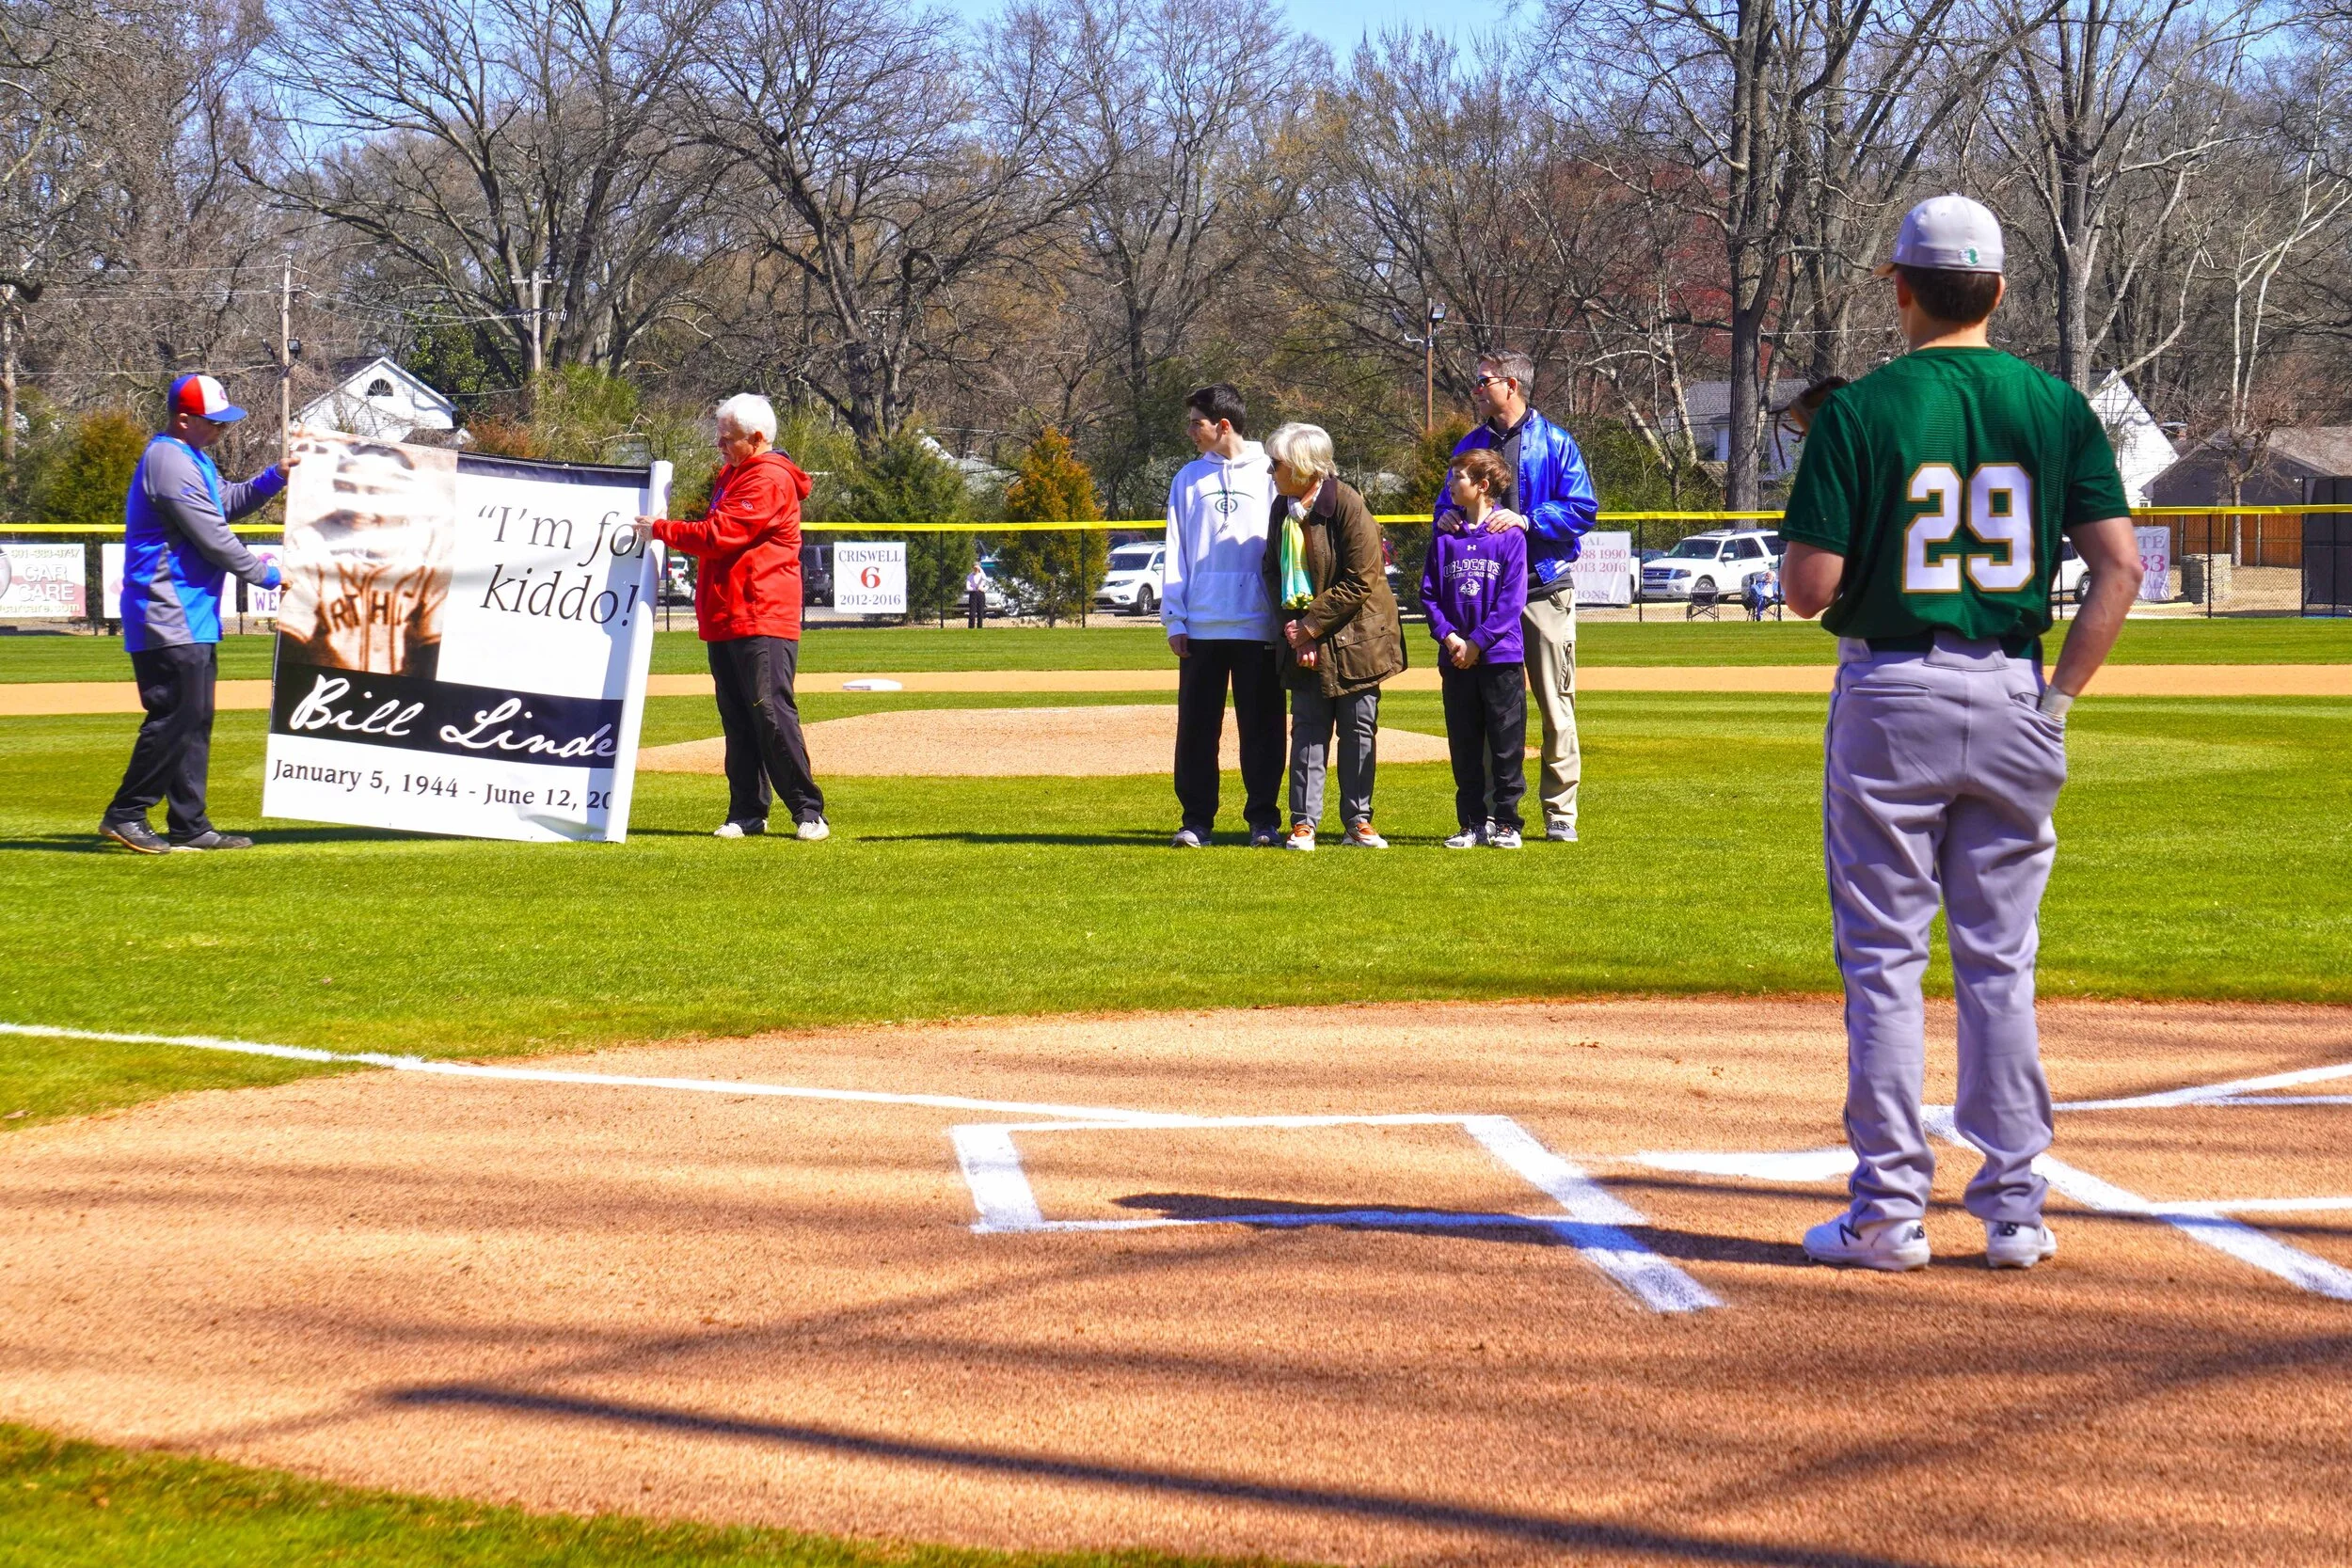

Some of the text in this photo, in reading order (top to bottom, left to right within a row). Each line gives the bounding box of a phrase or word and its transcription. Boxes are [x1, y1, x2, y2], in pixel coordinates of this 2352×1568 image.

[1902, 462, 2035, 593] 29
[838, 550, 901, 562] CRISWELL
[1599, 549, 1626, 560] 1990
[24, 564, 68, 582] CAR
[1571, 562, 1626, 573] 2013 2016
[861, 566, 881, 589] 6
[19, 583, 75, 602] CARE
[255, 592, 281, 610] WE
[480, 563, 639, 626] kiddo!
[840, 594, 901, 606] 2012-2016
[289, 673, 425, 736] Bill
[273, 759, 361, 792] January
[370, 770, 389, 794] 5,
[403, 774, 458, 798] 1944
[484, 784, 534, 805] June
[546, 788, 577, 811] 12,
